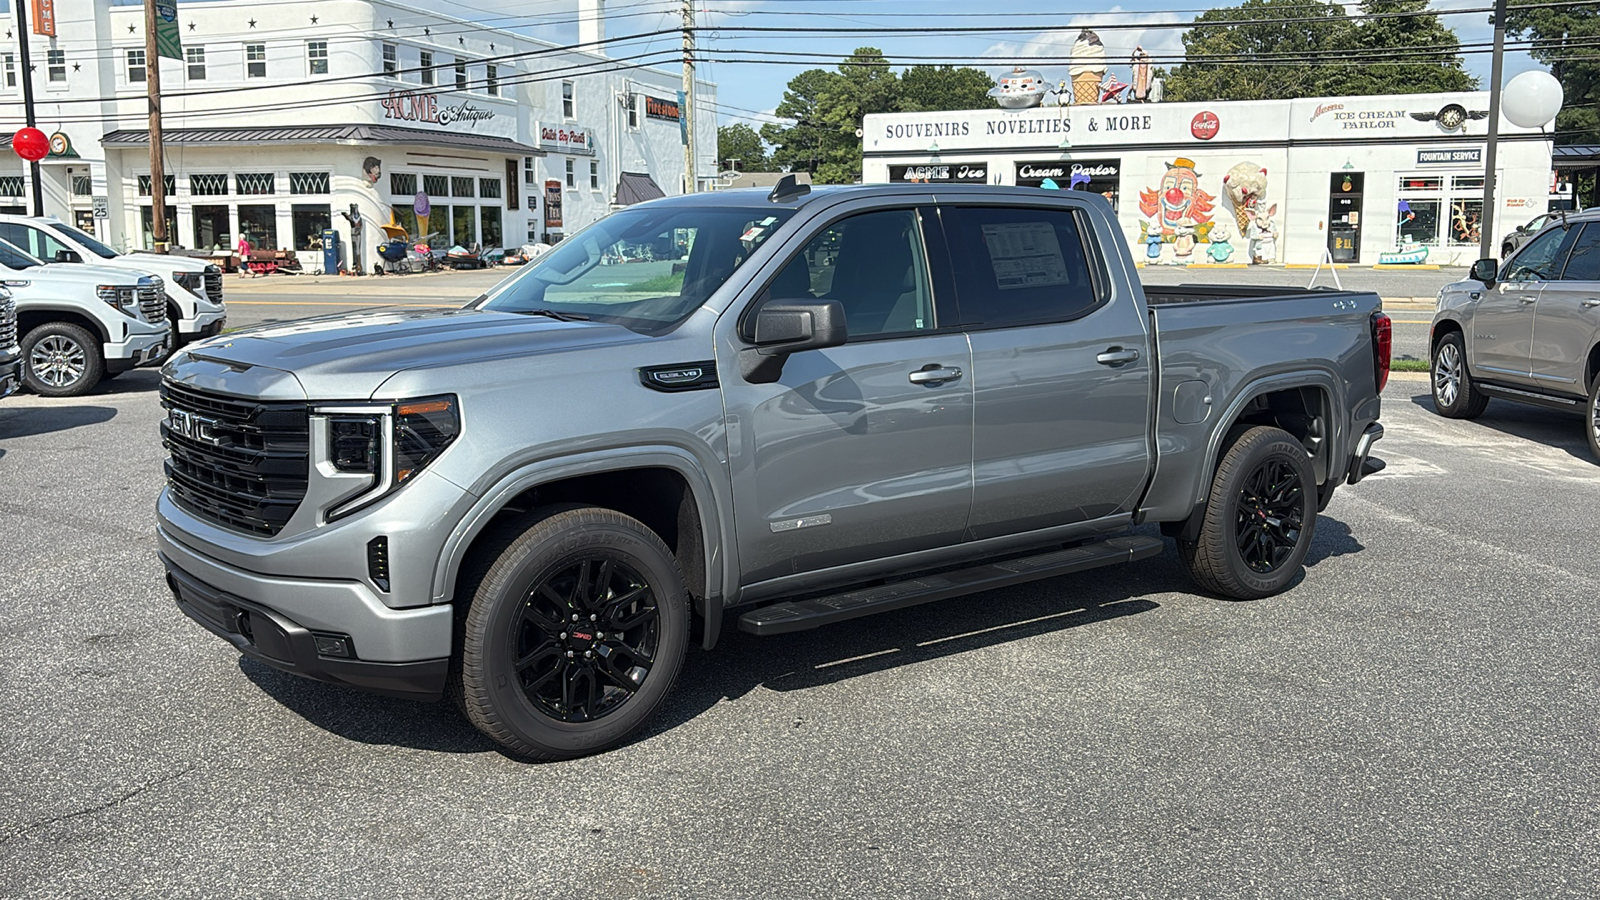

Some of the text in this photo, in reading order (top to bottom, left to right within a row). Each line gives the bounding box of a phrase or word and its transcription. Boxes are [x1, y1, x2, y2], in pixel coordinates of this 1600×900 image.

[381, 88, 495, 128] ACME Antiques
[1334, 110, 1406, 120] ICE CREAM
[886, 115, 1152, 139] SOUVENIRS NOVELTIES & MORE
[1342, 120, 1395, 129] PARLOR
[542, 127, 557, 140] Dutch
[559, 129, 569, 145] Boy
[1420, 151, 1479, 161] FOUNTAIN SERVICE
[904, 165, 985, 180] ACME Ice
[1019, 163, 1118, 178] Cream Parlor
[94, 208, 107, 217] 25
[171, 407, 220, 447] GMC
[572, 631, 592, 641] GMC
